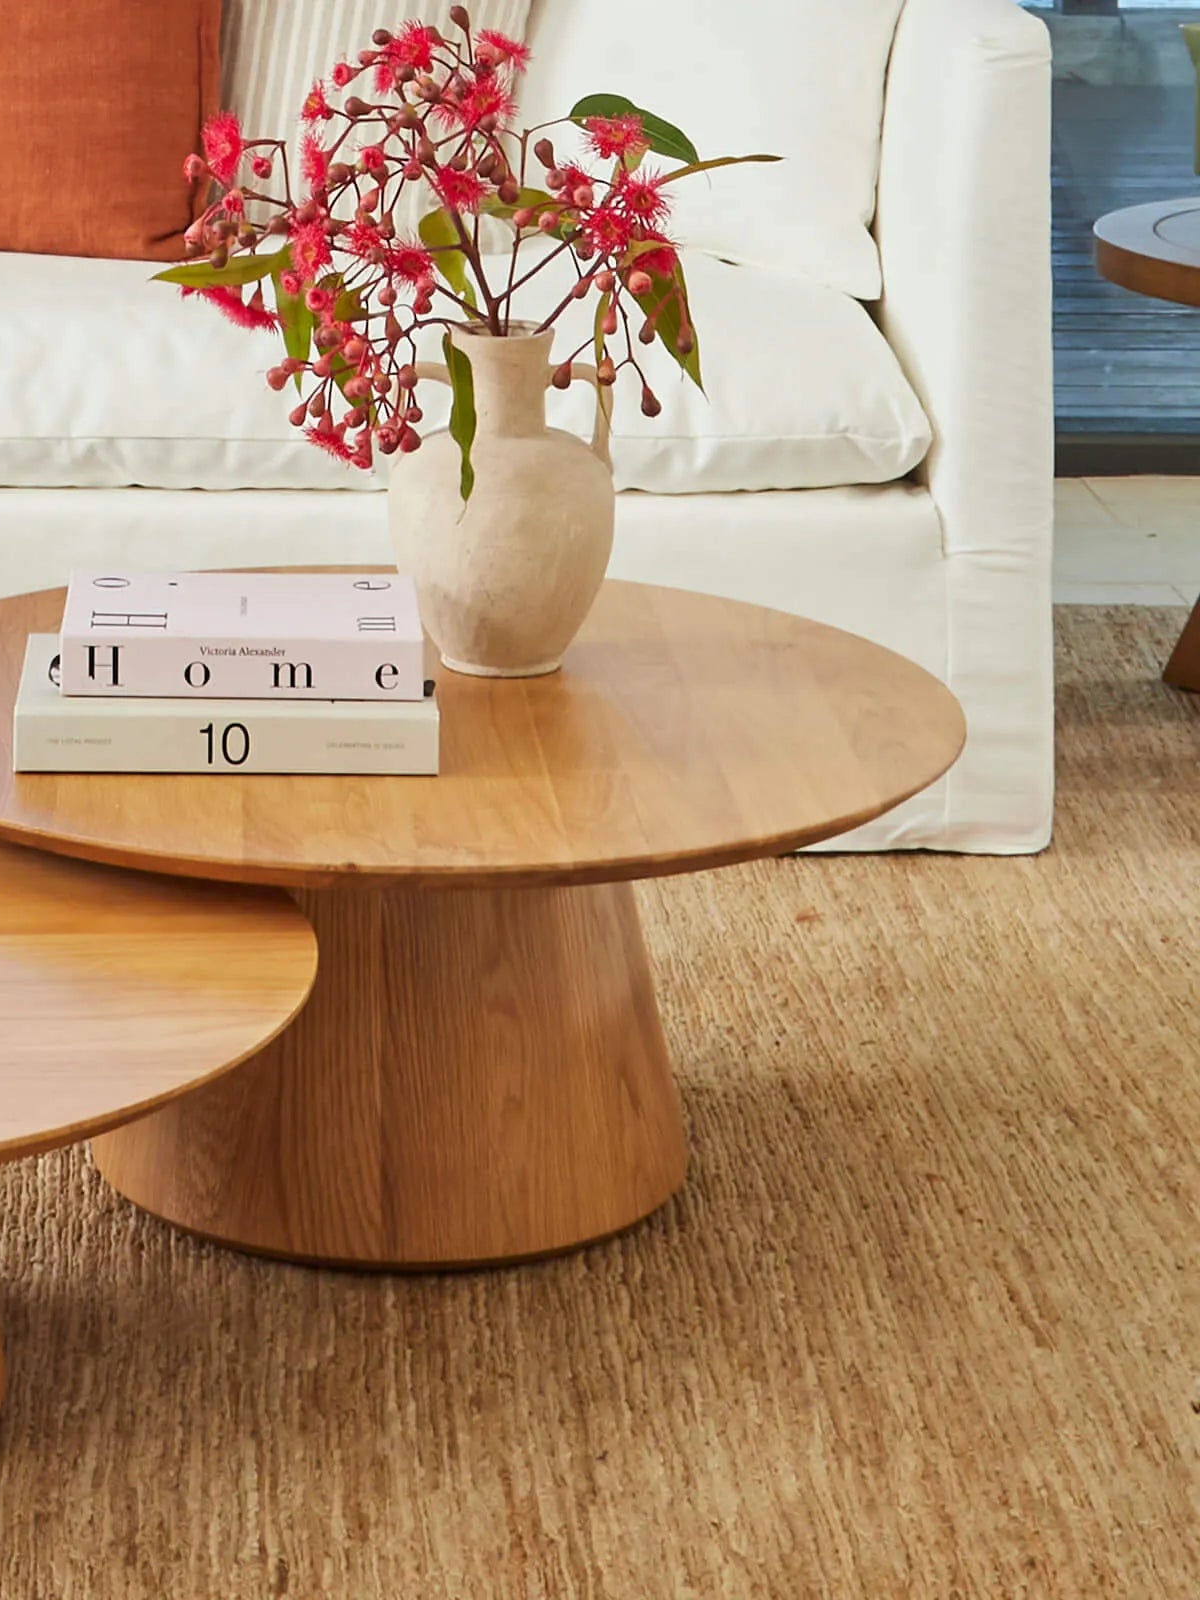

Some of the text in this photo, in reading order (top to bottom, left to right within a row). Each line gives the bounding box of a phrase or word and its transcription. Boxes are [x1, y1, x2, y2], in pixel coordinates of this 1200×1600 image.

[199, 646, 286, 657] Victoria Alexander
[199, 722, 251, 766] 10
